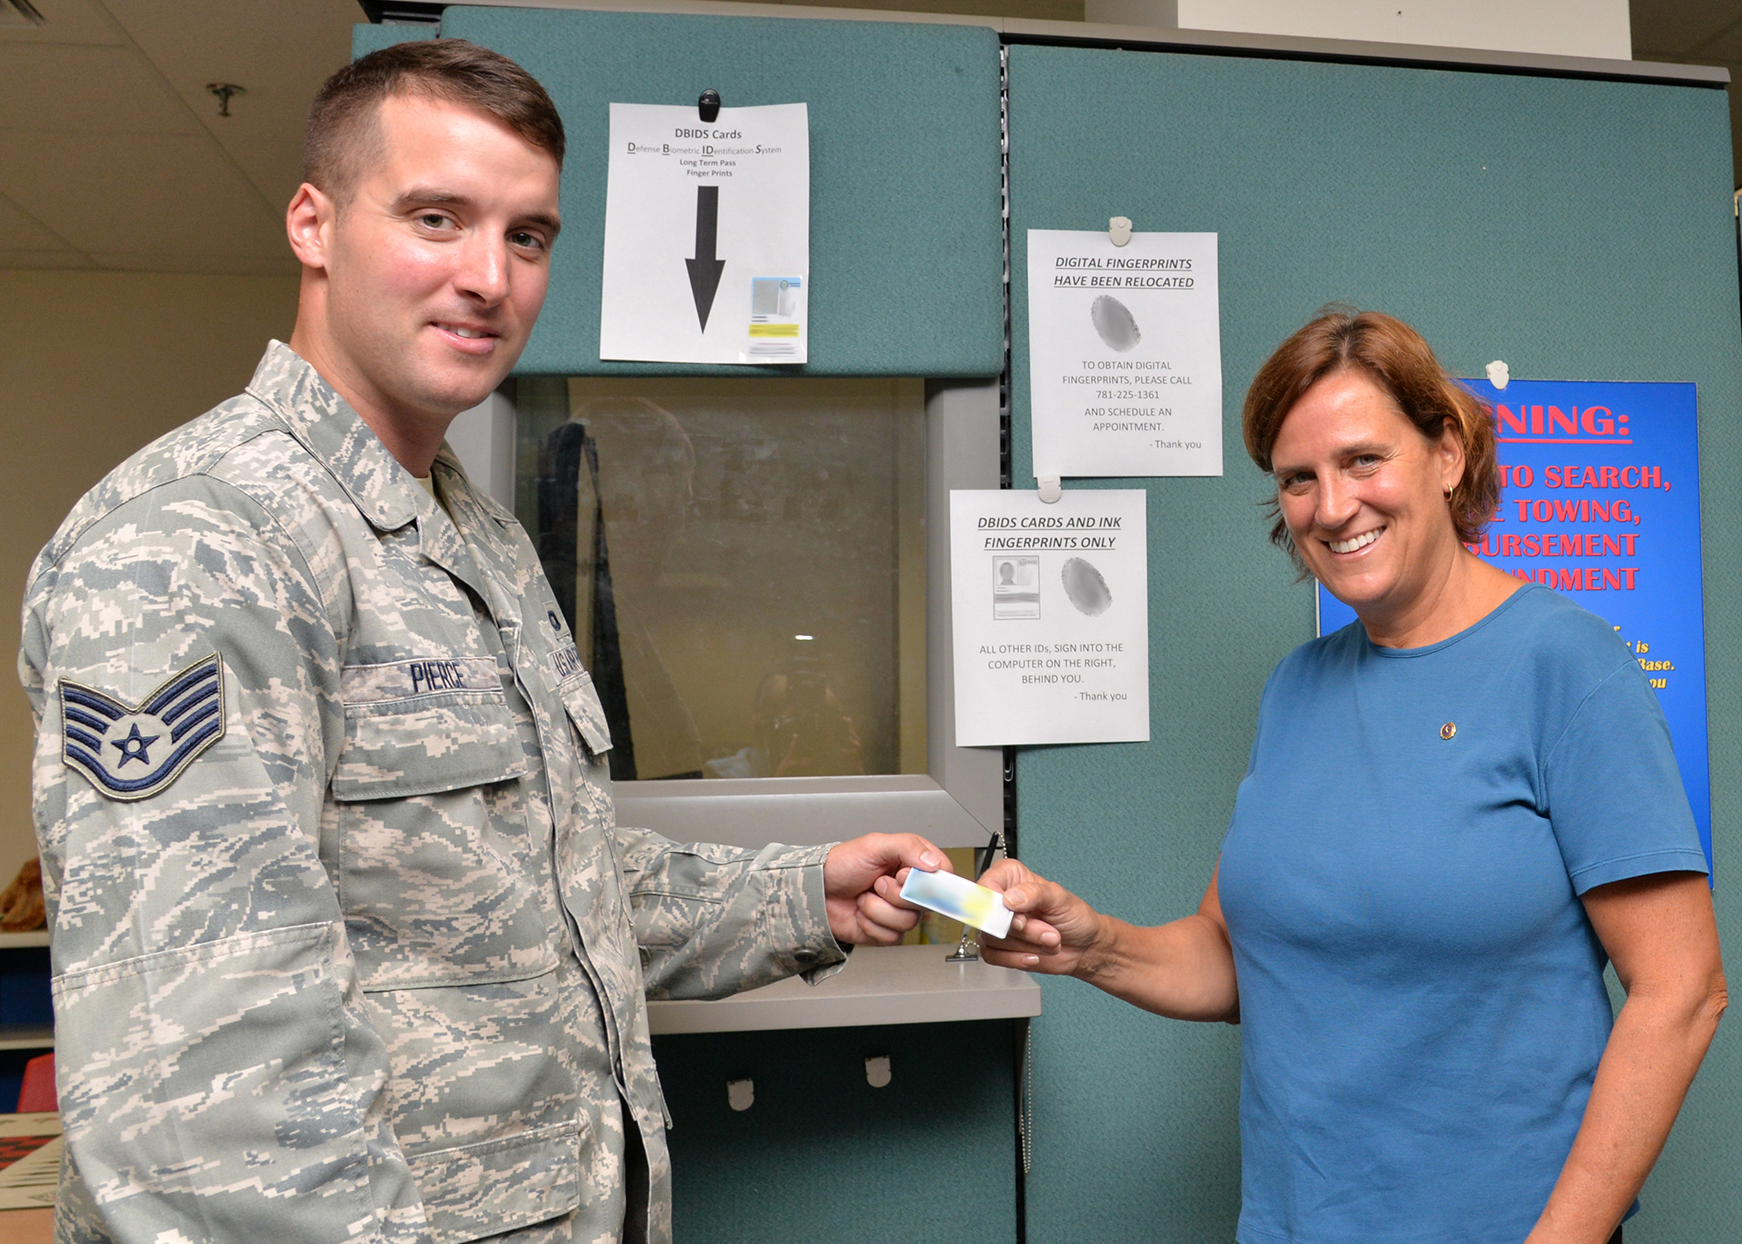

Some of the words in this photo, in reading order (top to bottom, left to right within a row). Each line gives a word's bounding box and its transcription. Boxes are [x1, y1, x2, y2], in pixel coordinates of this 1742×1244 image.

[674, 128, 710, 140] DBIDS
[712, 129, 742, 140] Cards
[627, 141, 661, 154] Defense
[662, 143, 699, 154] Biometric
[702, 145, 754, 155] IDentification
[754, 144, 782, 155] System
[679, 158, 698, 168] Long
[698, 159, 719, 167] Term
[719, 159, 737, 167] Pass
[686, 169, 710, 178] Finger
[711, 169, 733, 177] Prints
[1055, 256, 1103, 268] DIGITAL
[1104, 258, 1193, 271] FINGERPRINTS
[1054, 275, 1088, 288] HAVE
[1090, 276, 1122, 287] BEEN
[1123, 276, 1195, 289] RELOCATED
[1081, 360, 1096, 370] TO
[1097, 360, 1133, 370] OBTAIN
[1135, 361, 1172, 370] DIGITAL
[1062, 375, 1132, 386] FINGERPRINTS,
[1134, 375, 1168, 385] PLEASE
[1169, 375, 1192, 385] CALL
[1096, 390, 1160, 400] 781-225-1361
[1084, 407, 1106, 417] AND
[1107, 407, 1156, 417] SCHEDULE
[1158, 407, 1172, 417] AN
[1496, 405, 1630, 436] NING:
[1092, 422, 1165, 432] APPOINTMENT.
[1154, 439, 1183, 449] Thank
[1184, 441, 1202, 451] you
[1498, 465, 1534, 489] TO
[1544, 465, 1671, 492] SEARCH,
[1513, 500, 1641, 526] TOWING,
[977, 517, 1018, 529] DBIDS
[1020, 516, 1064, 529] CARDS
[1065, 517, 1096, 528] AND
[1098, 516, 1122, 528] INK
[984, 536, 1078, 549] FINGERPRINTS
[1080, 536, 1116, 548] ONLY
[979, 645, 997, 655] ALL
[998, 644, 1032, 654] OTHER
[1034, 643, 1052, 654] IDs,
[1054, 643, 1077, 653] SIGN
[1079, 643, 1104, 653] INTO
[1104, 643, 1124, 653] THE
[1636, 641, 1649, 653] is
[987, 659, 1044, 670] COMPUTER
[1045, 659, 1061, 669] ON
[1063, 658, 1082, 668] THE
[1084, 658, 1116, 669] RIGHT,
[410, 662, 467, 692] PIERCE
[1021, 674, 1059, 684] BEHIND
[1060, 674, 1084, 684] YOU.
[1079, 691, 1108, 701] Thank
[1109, 693, 1128, 703] you
